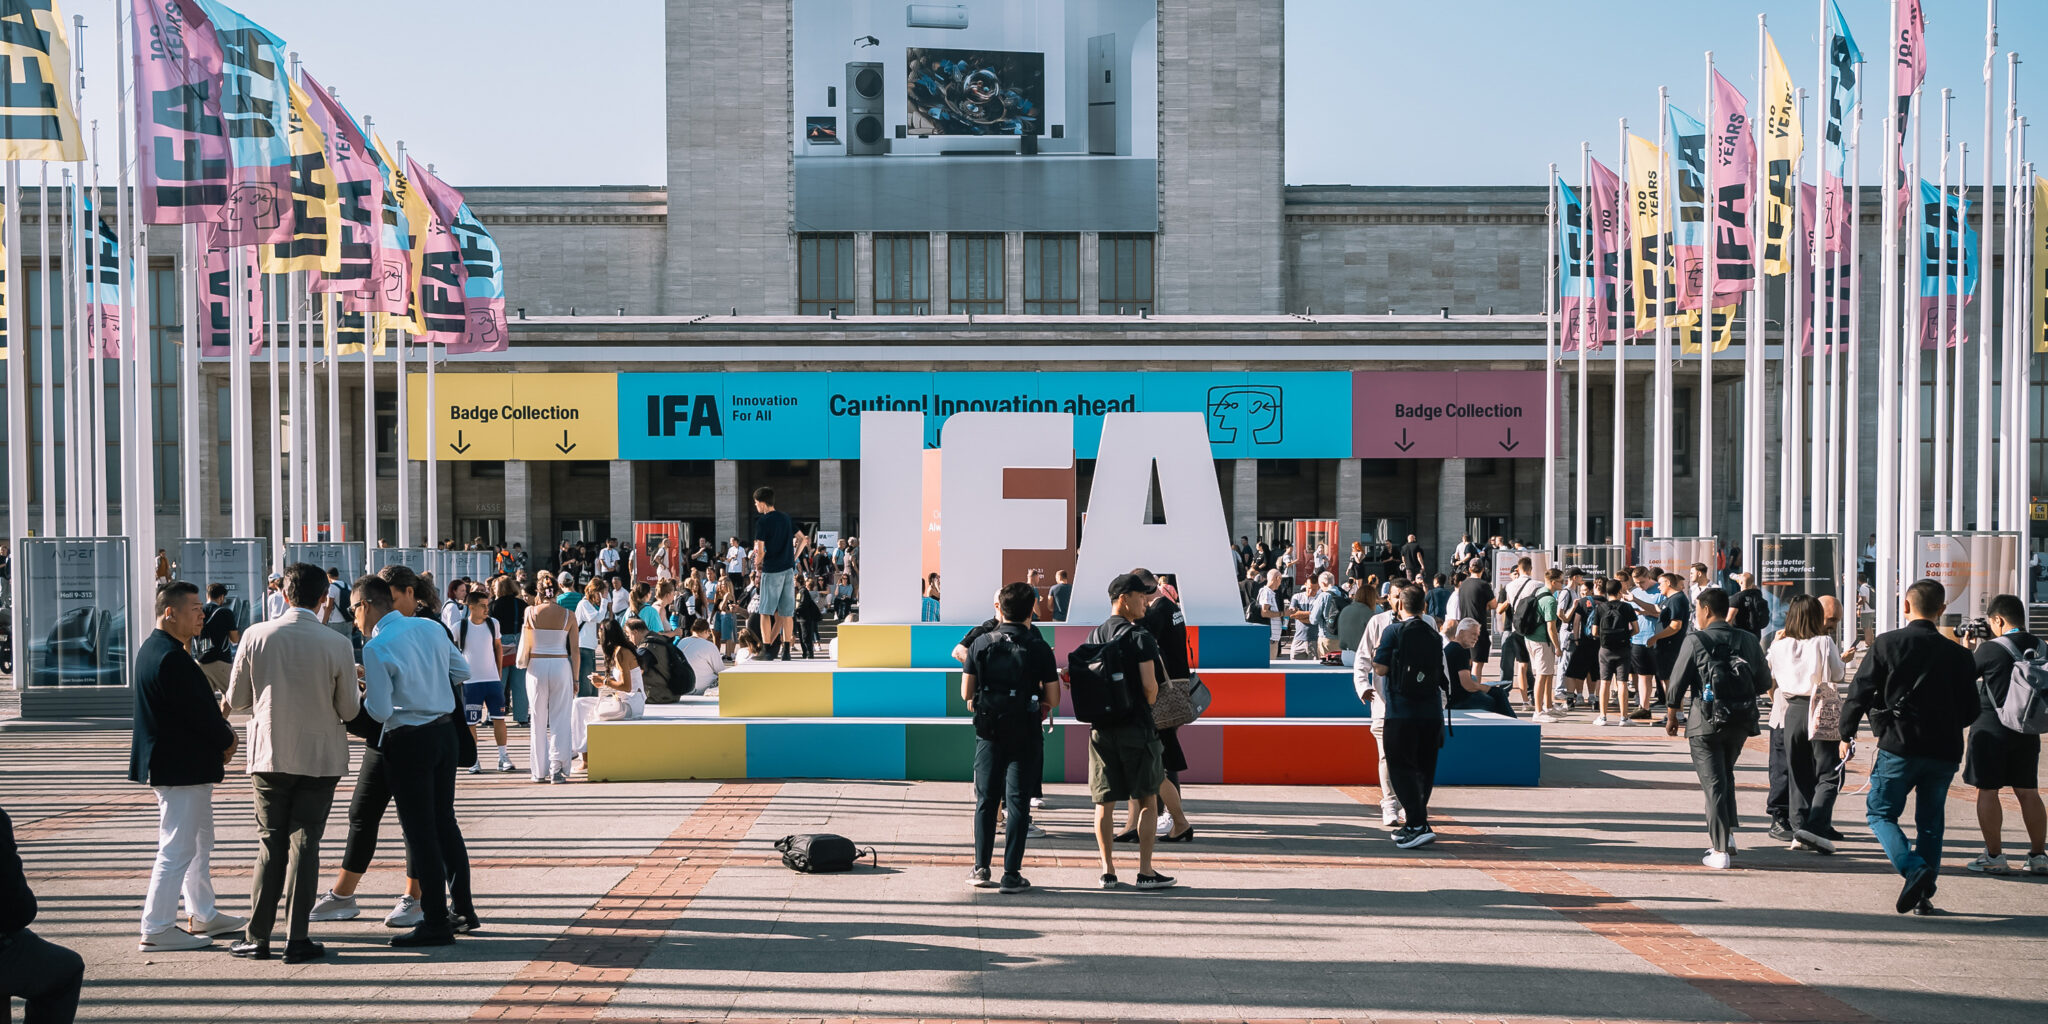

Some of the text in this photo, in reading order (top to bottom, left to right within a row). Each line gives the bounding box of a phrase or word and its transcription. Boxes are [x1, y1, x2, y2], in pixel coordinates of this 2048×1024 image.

[150, 24, 163, 61] 100
[152, 79, 227, 207] IFA
[1723, 113, 1745, 167] YEARS
[1639, 190, 1647, 216] 100
[1648, 170, 1659, 218] YEARS
[1765, 159, 1790, 261] IFA
[321, 180, 372, 280] IFA
[1603, 209, 1611, 233] 100
[1717, 183, 1755, 280] IFA
[1925, 202, 1969, 277] IFA
[422, 251, 466, 333] IFA
[1604, 249, 1634, 329] IFA
[1642, 232, 1677, 318] IFA
[450, 404, 579, 423] Badge Collection
[647, 395, 723, 436] IFA
[732, 394, 798, 406] Innovation
[732, 409, 772, 421] For All
[829, 393, 928, 416] Caution!
[934, 394, 1058, 416] Innovation
[1395, 403, 1523, 421] Badge Collection
[476, 503, 500, 511] KASSE
[860, 411, 1246, 626] IFA
[470, 710, 478, 720] 13
